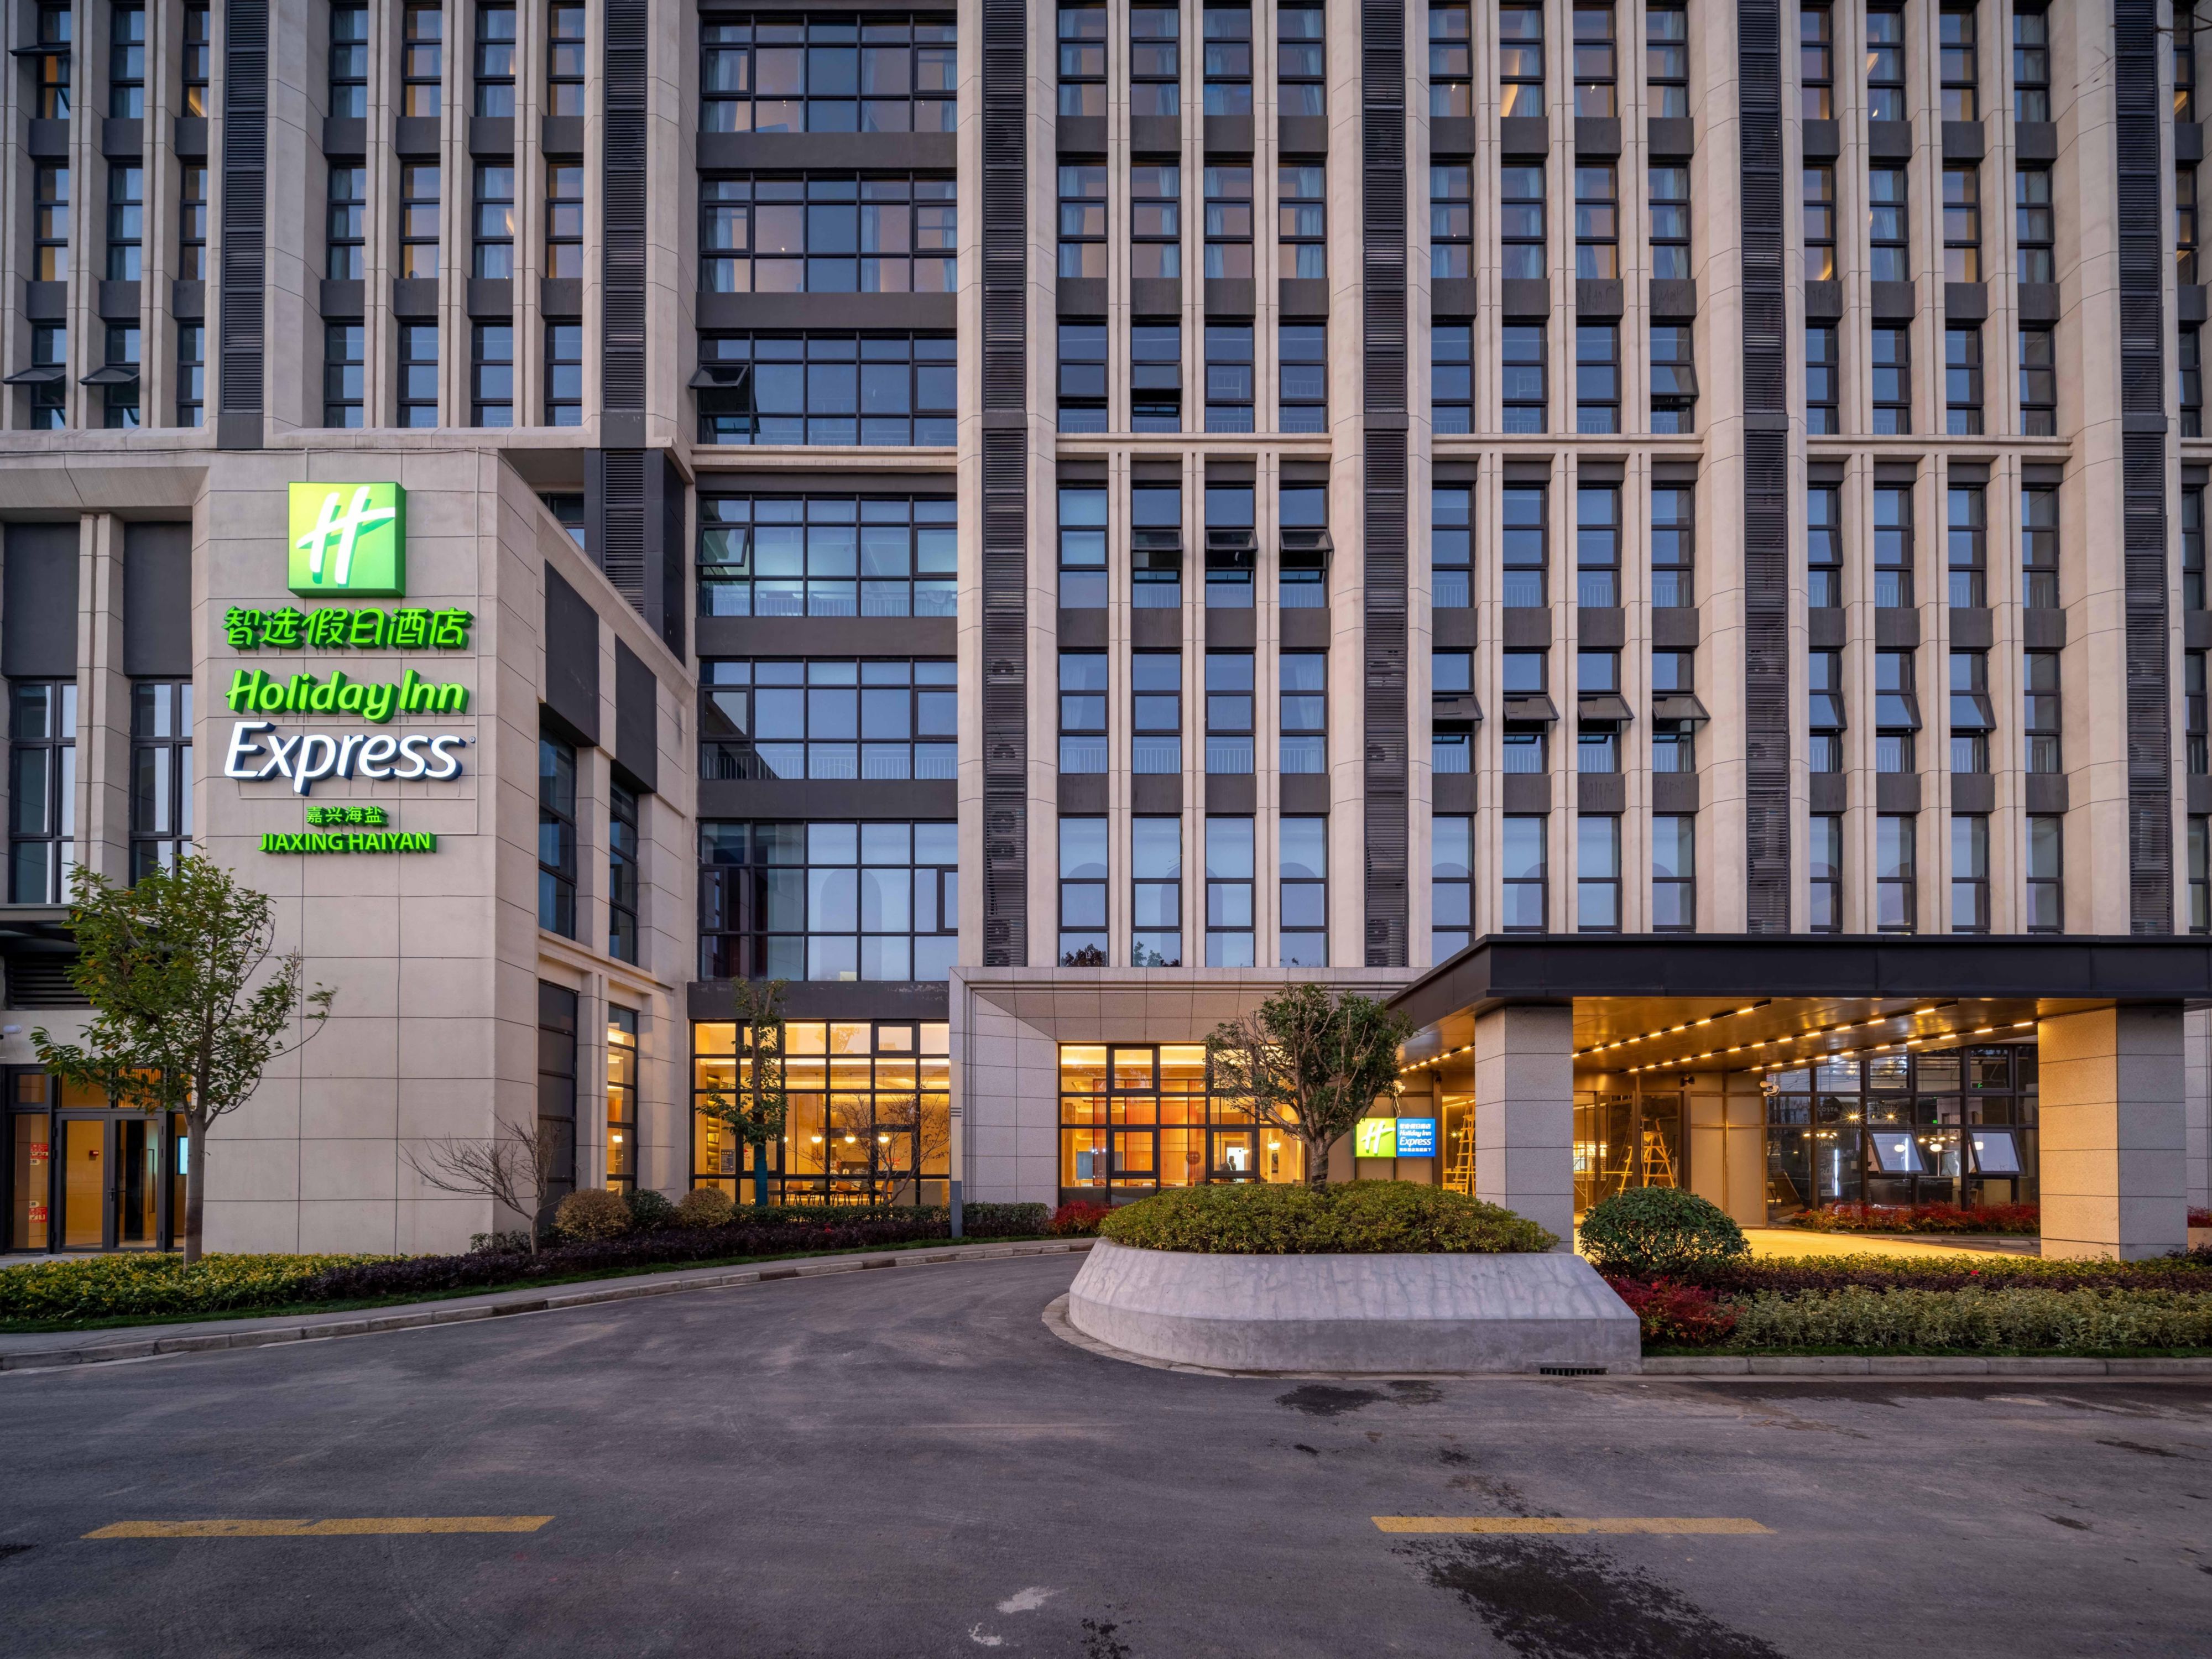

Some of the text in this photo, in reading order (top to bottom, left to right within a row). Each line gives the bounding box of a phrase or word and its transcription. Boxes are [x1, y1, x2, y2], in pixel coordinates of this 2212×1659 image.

[222, 606, 471, 648] 智选假日酒店
[226, 669, 467, 722] Holiday Inn
[306, 806, 386, 825] 嘉兴海盐
[258, 832, 435, 852] JIAXING HAIYAN
[1400, 1137, 1432, 1147] Express
